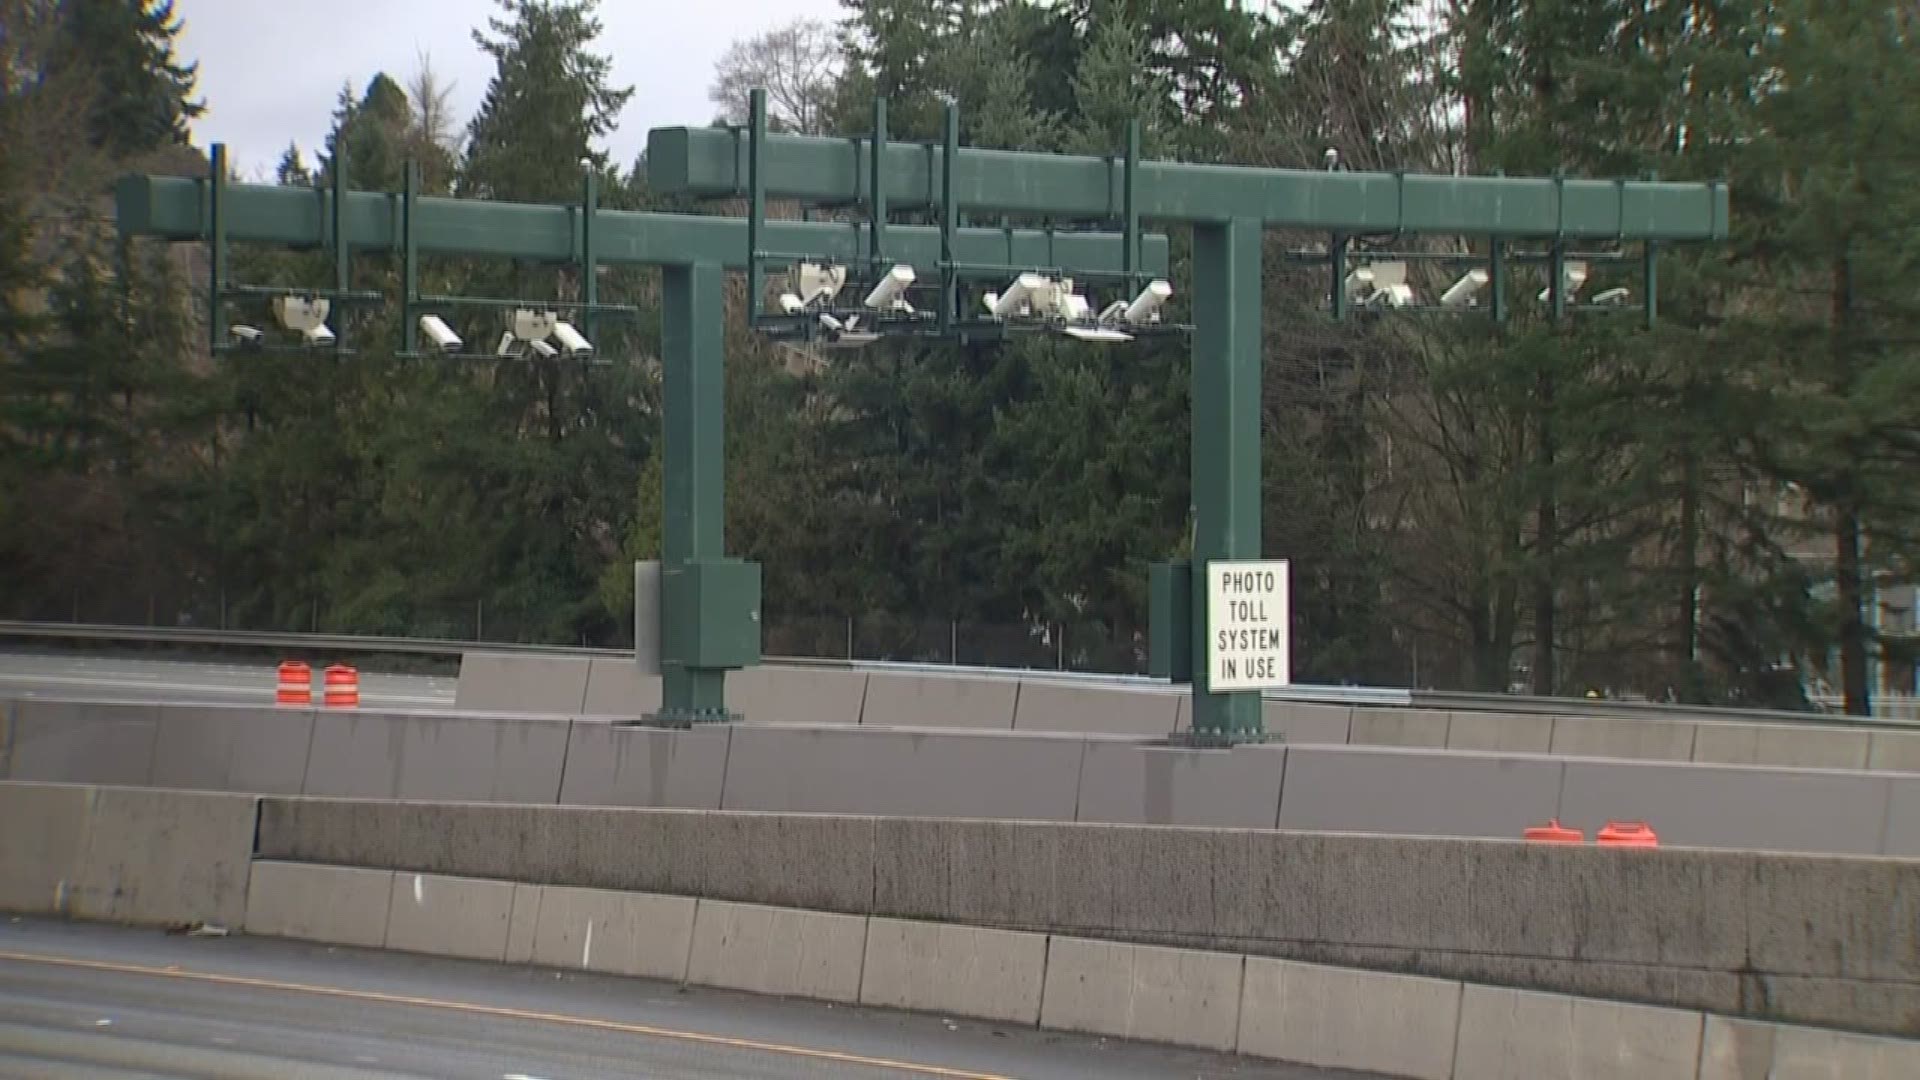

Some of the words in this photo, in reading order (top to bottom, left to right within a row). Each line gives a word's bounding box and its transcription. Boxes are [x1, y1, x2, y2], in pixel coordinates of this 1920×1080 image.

[1222, 571, 1274, 593] PHOTO
[1229, 600, 1268, 622] TOLL
[1218, 629, 1280, 651] SYSTEM
[1221, 658, 1237, 679] IN
[1245, 657, 1276, 678] USE
